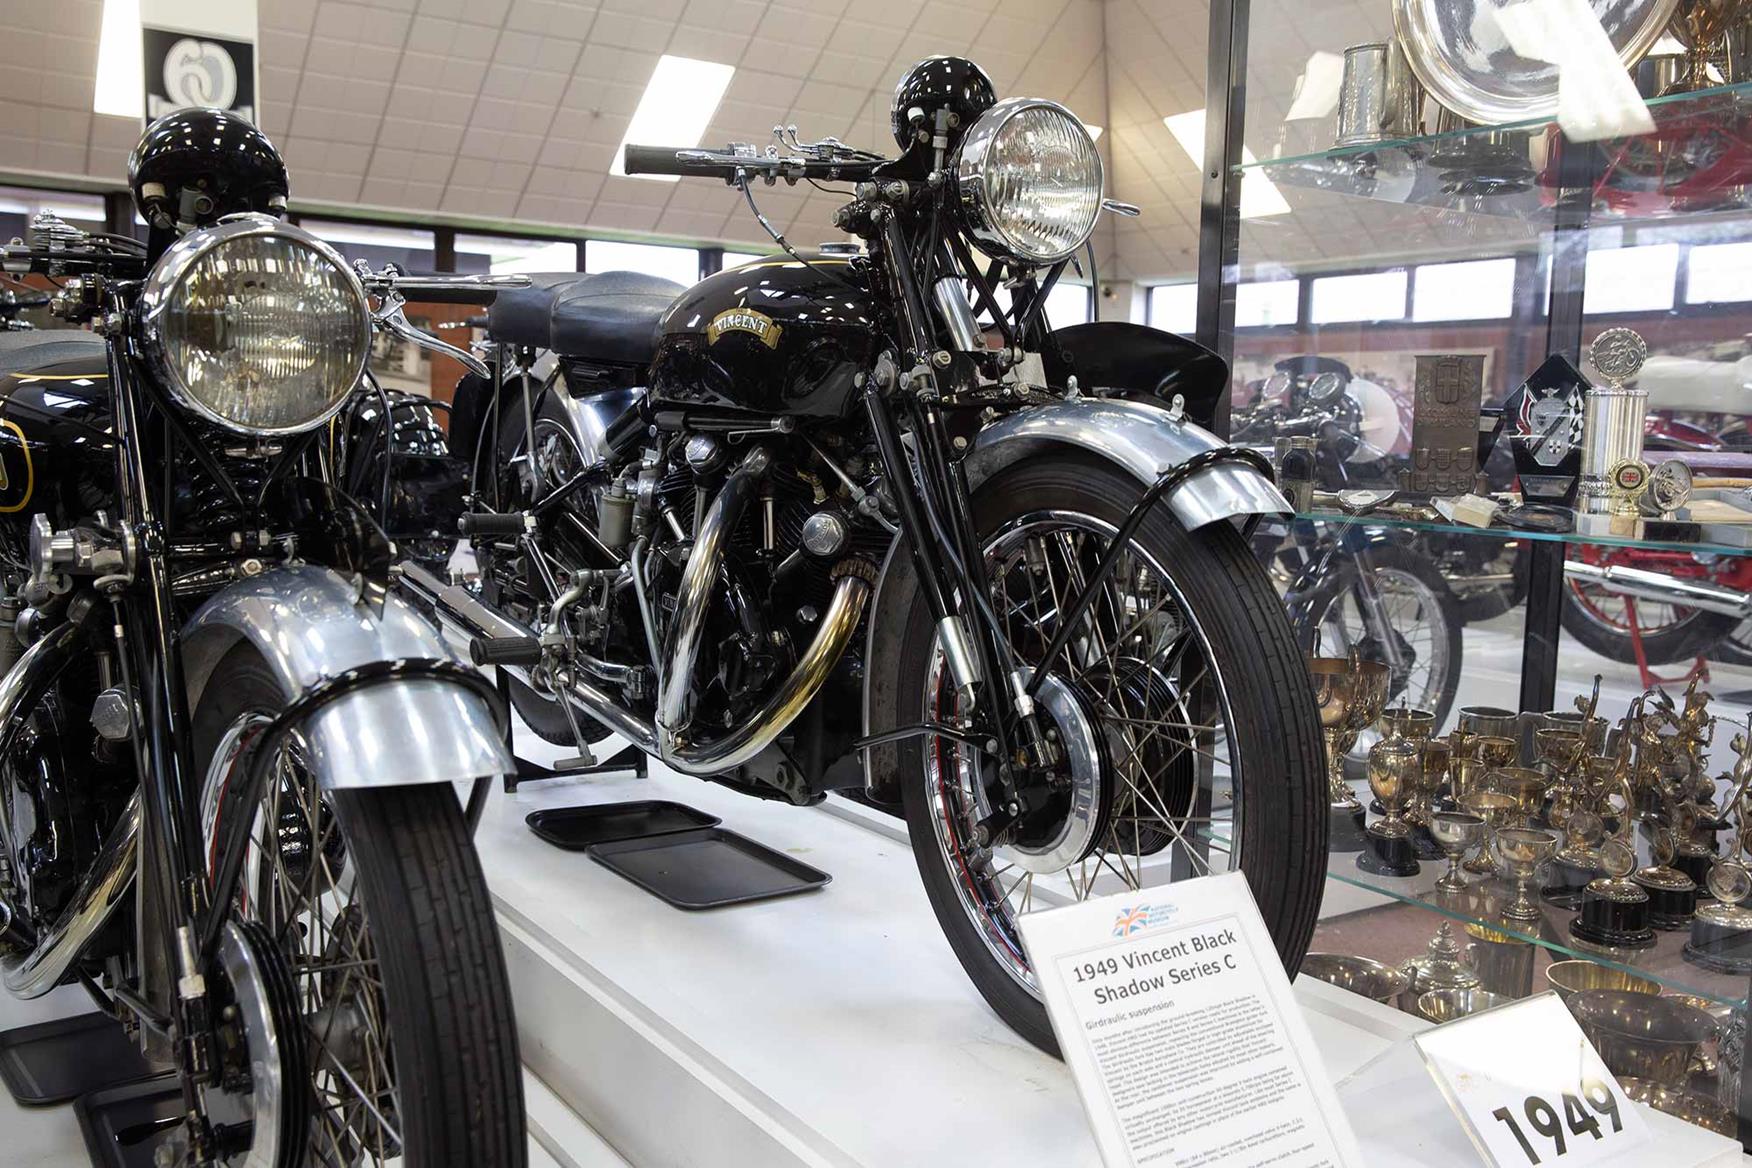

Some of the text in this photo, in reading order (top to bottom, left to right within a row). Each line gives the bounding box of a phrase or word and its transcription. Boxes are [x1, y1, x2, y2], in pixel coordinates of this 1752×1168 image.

[715, 313, 768, 334] VINCENT
[1073, 929, 1237, 983] 1949 Vincent Black
[1094, 954, 1237, 1005] Shadow Series C
[1085, 1000, 1175, 1030] Girdraulic suspension
[1492, 1079, 1624, 1166] 1949
